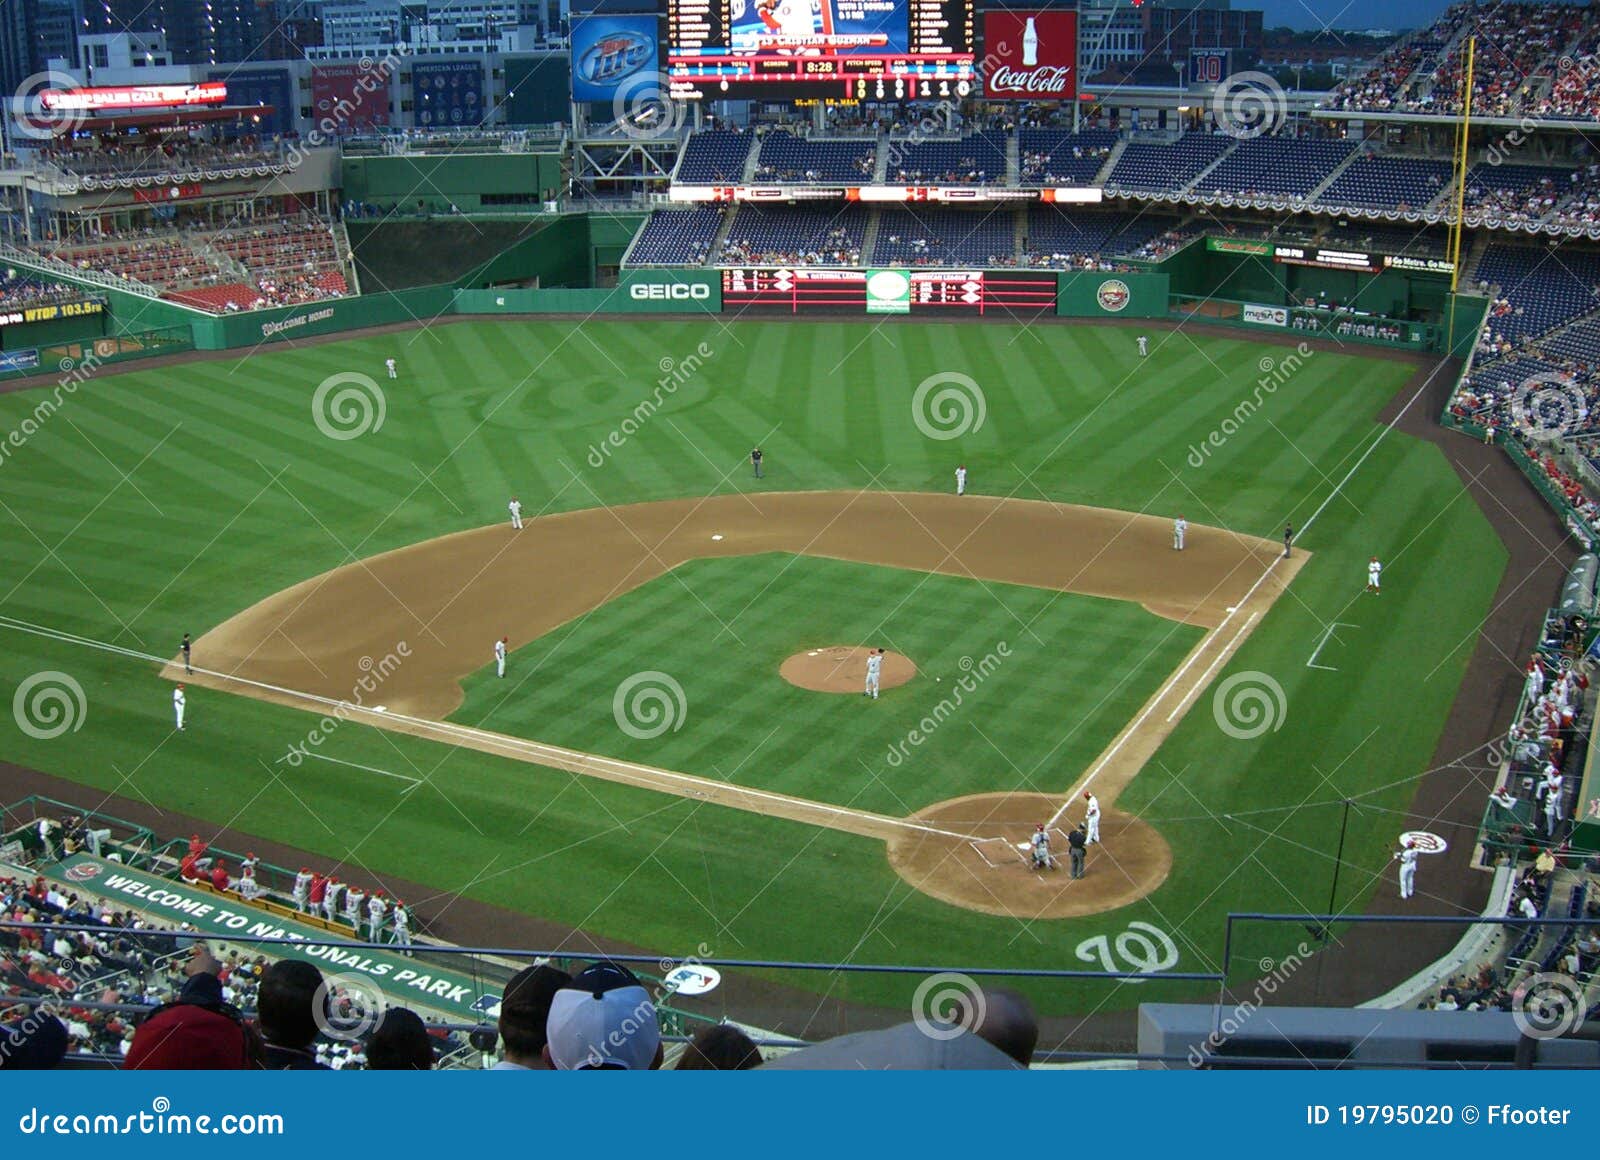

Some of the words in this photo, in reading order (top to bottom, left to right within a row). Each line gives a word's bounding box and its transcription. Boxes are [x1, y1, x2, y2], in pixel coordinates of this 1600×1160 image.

[415, 64, 451, 74] AMERICAN
[452, 63, 480, 73] LEAGUE
[807, 61, 834, 73] 8:28
[1197, 56, 1221, 82] 10
[630, 284, 710, 299] GEICO
[25, 306, 58, 321] WTOP
[262, 315, 307, 337] WELCOME
[104, 873, 215, 918] WELCOME
[213, 909, 249, 930] TO
[393, 969, 472, 1003] PARK
